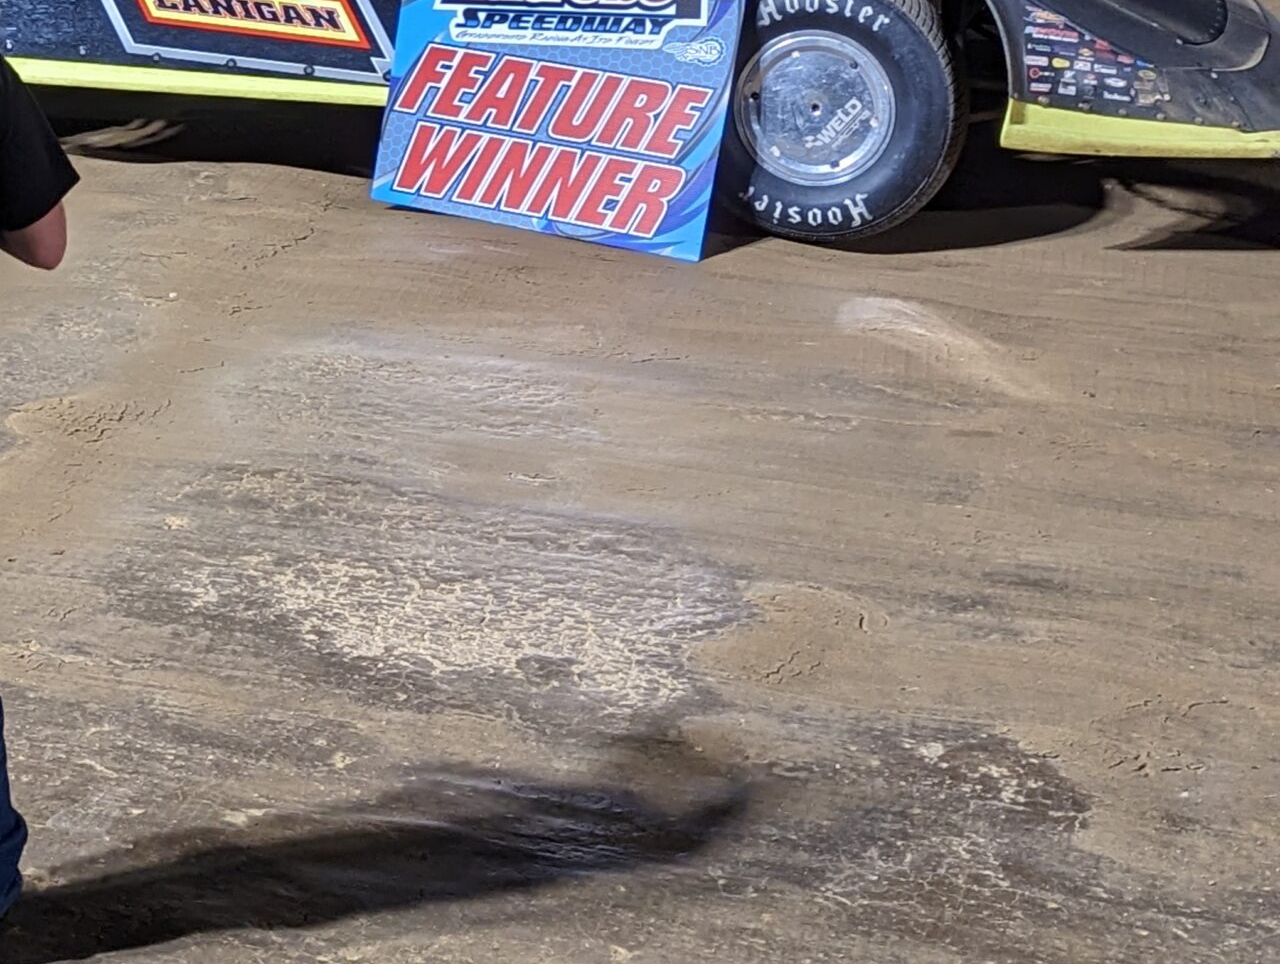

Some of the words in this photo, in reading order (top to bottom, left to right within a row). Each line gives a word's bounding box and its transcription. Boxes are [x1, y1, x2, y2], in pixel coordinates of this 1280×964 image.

[455, 8, 674, 35] SPEEDWAY
[394, 44, 714, 158] FEATURE
[819, 97, 863, 147] WELD
[392, 121, 686, 238] WINNER
[738, 185, 874, 229] Hoosier
